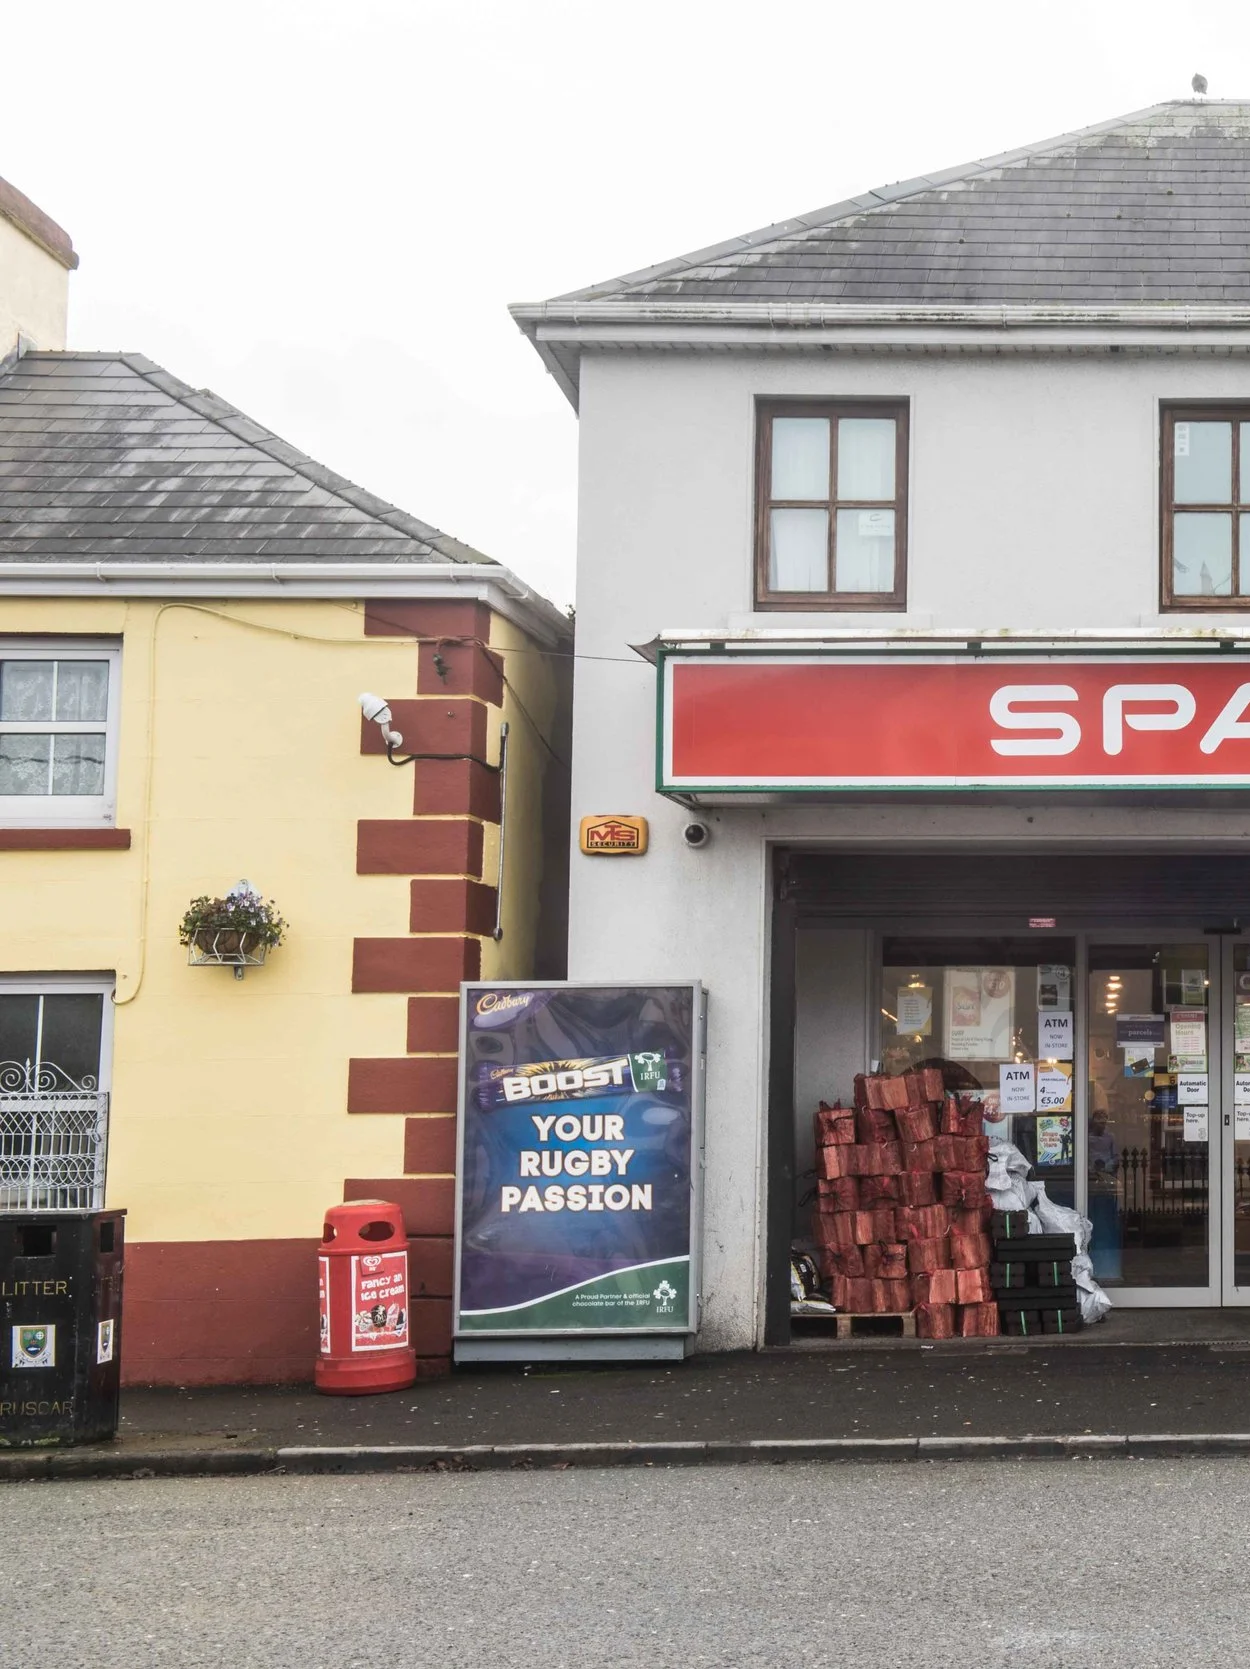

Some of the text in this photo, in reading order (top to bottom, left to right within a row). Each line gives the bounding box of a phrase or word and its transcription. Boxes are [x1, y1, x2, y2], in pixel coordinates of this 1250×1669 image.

[476, 993, 530, 1015] Cadbury
[1044, 1018, 1068, 1028] ATM
[1128, 1029, 1152, 1037] parcels
[502, 1058, 628, 1102] BOOST
[640, 1071, 661, 1081] IRFU
[1005, 1071, 1030, 1081] ATM
[1040, 1086, 1046, 1094] 4
[1041, 1096, 1065, 1105] €5.00
[532, 1115, 624, 1142] YOUR
[519, 1149, 634, 1176] RUGBY
[501, 1184, 653, 1212] PASSION
[2, 1280, 68, 1296] LITTER
[378, 1285, 405, 1299] cream
